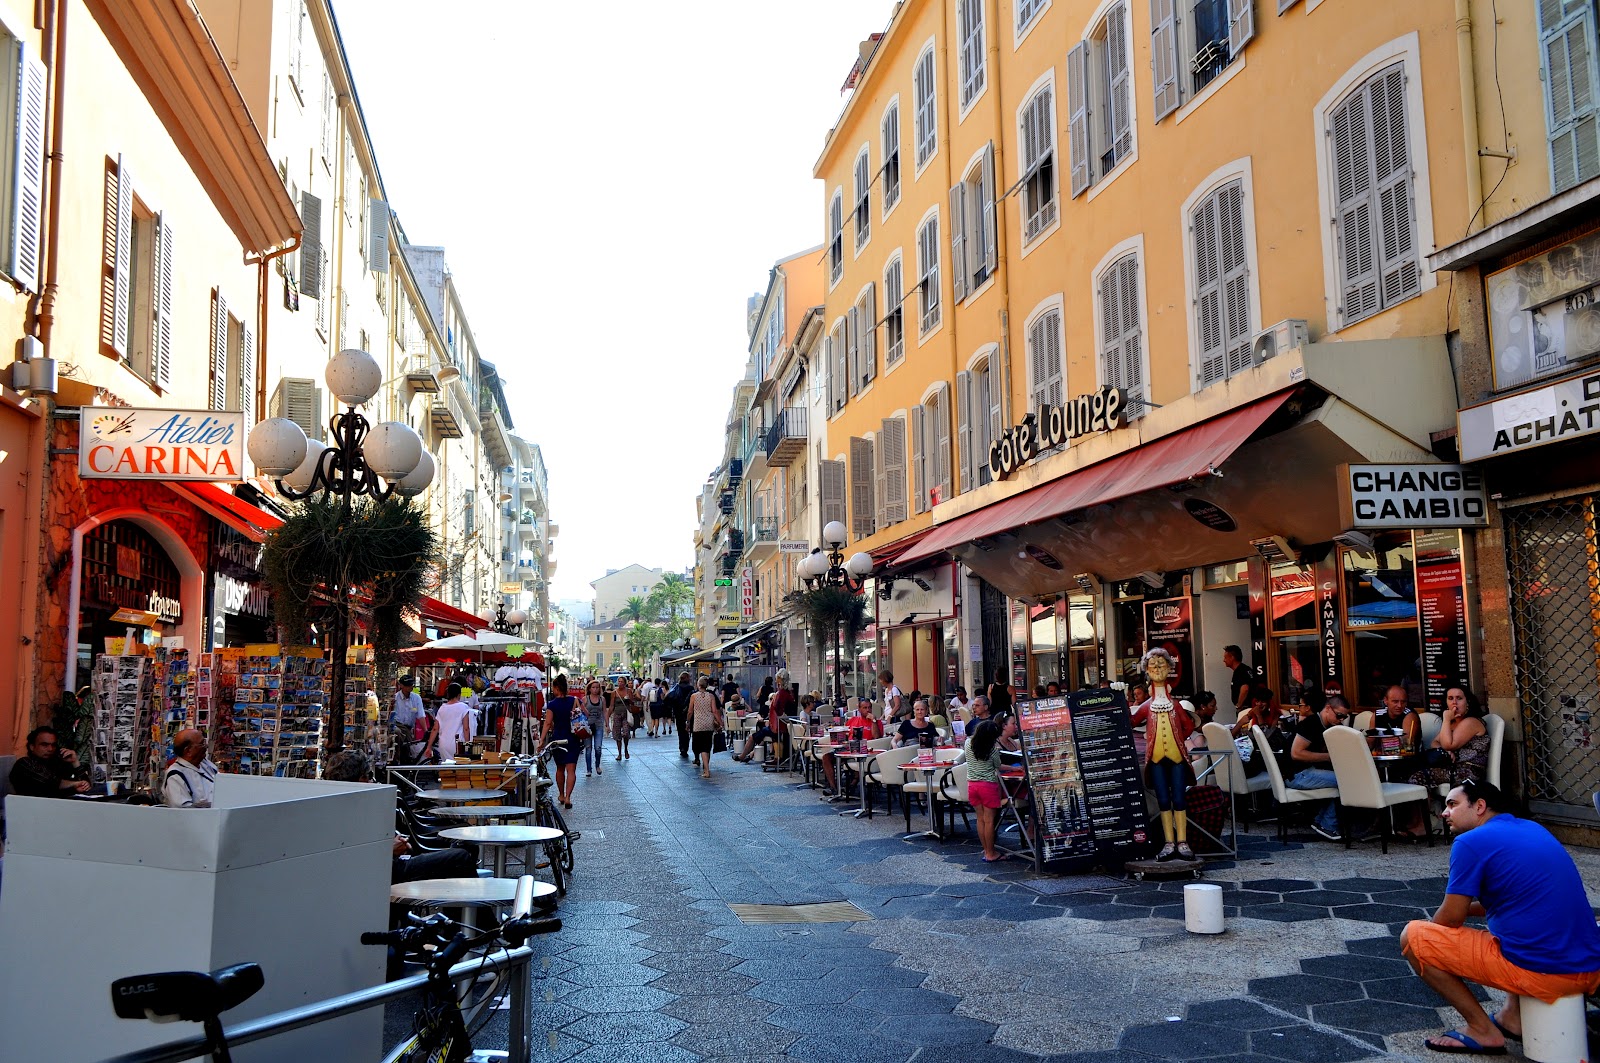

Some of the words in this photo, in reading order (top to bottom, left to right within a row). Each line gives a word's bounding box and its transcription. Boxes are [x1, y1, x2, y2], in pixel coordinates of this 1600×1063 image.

[135, 413, 235, 445] Atelier
[1038, 385, 1122, 452] Lounge
[88, 445, 238, 476] CARINA
[1352, 471, 1482, 492] CHANGE
[1355, 497, 1484, 519] CAMBIO
[225, 577, 270, 618] DISCOUNT
[742, 568, 752, 616] Canon
[1252, 593, 1264, 675] VINS
[1323, 582, 1336, 676] CHAMPAGNES
